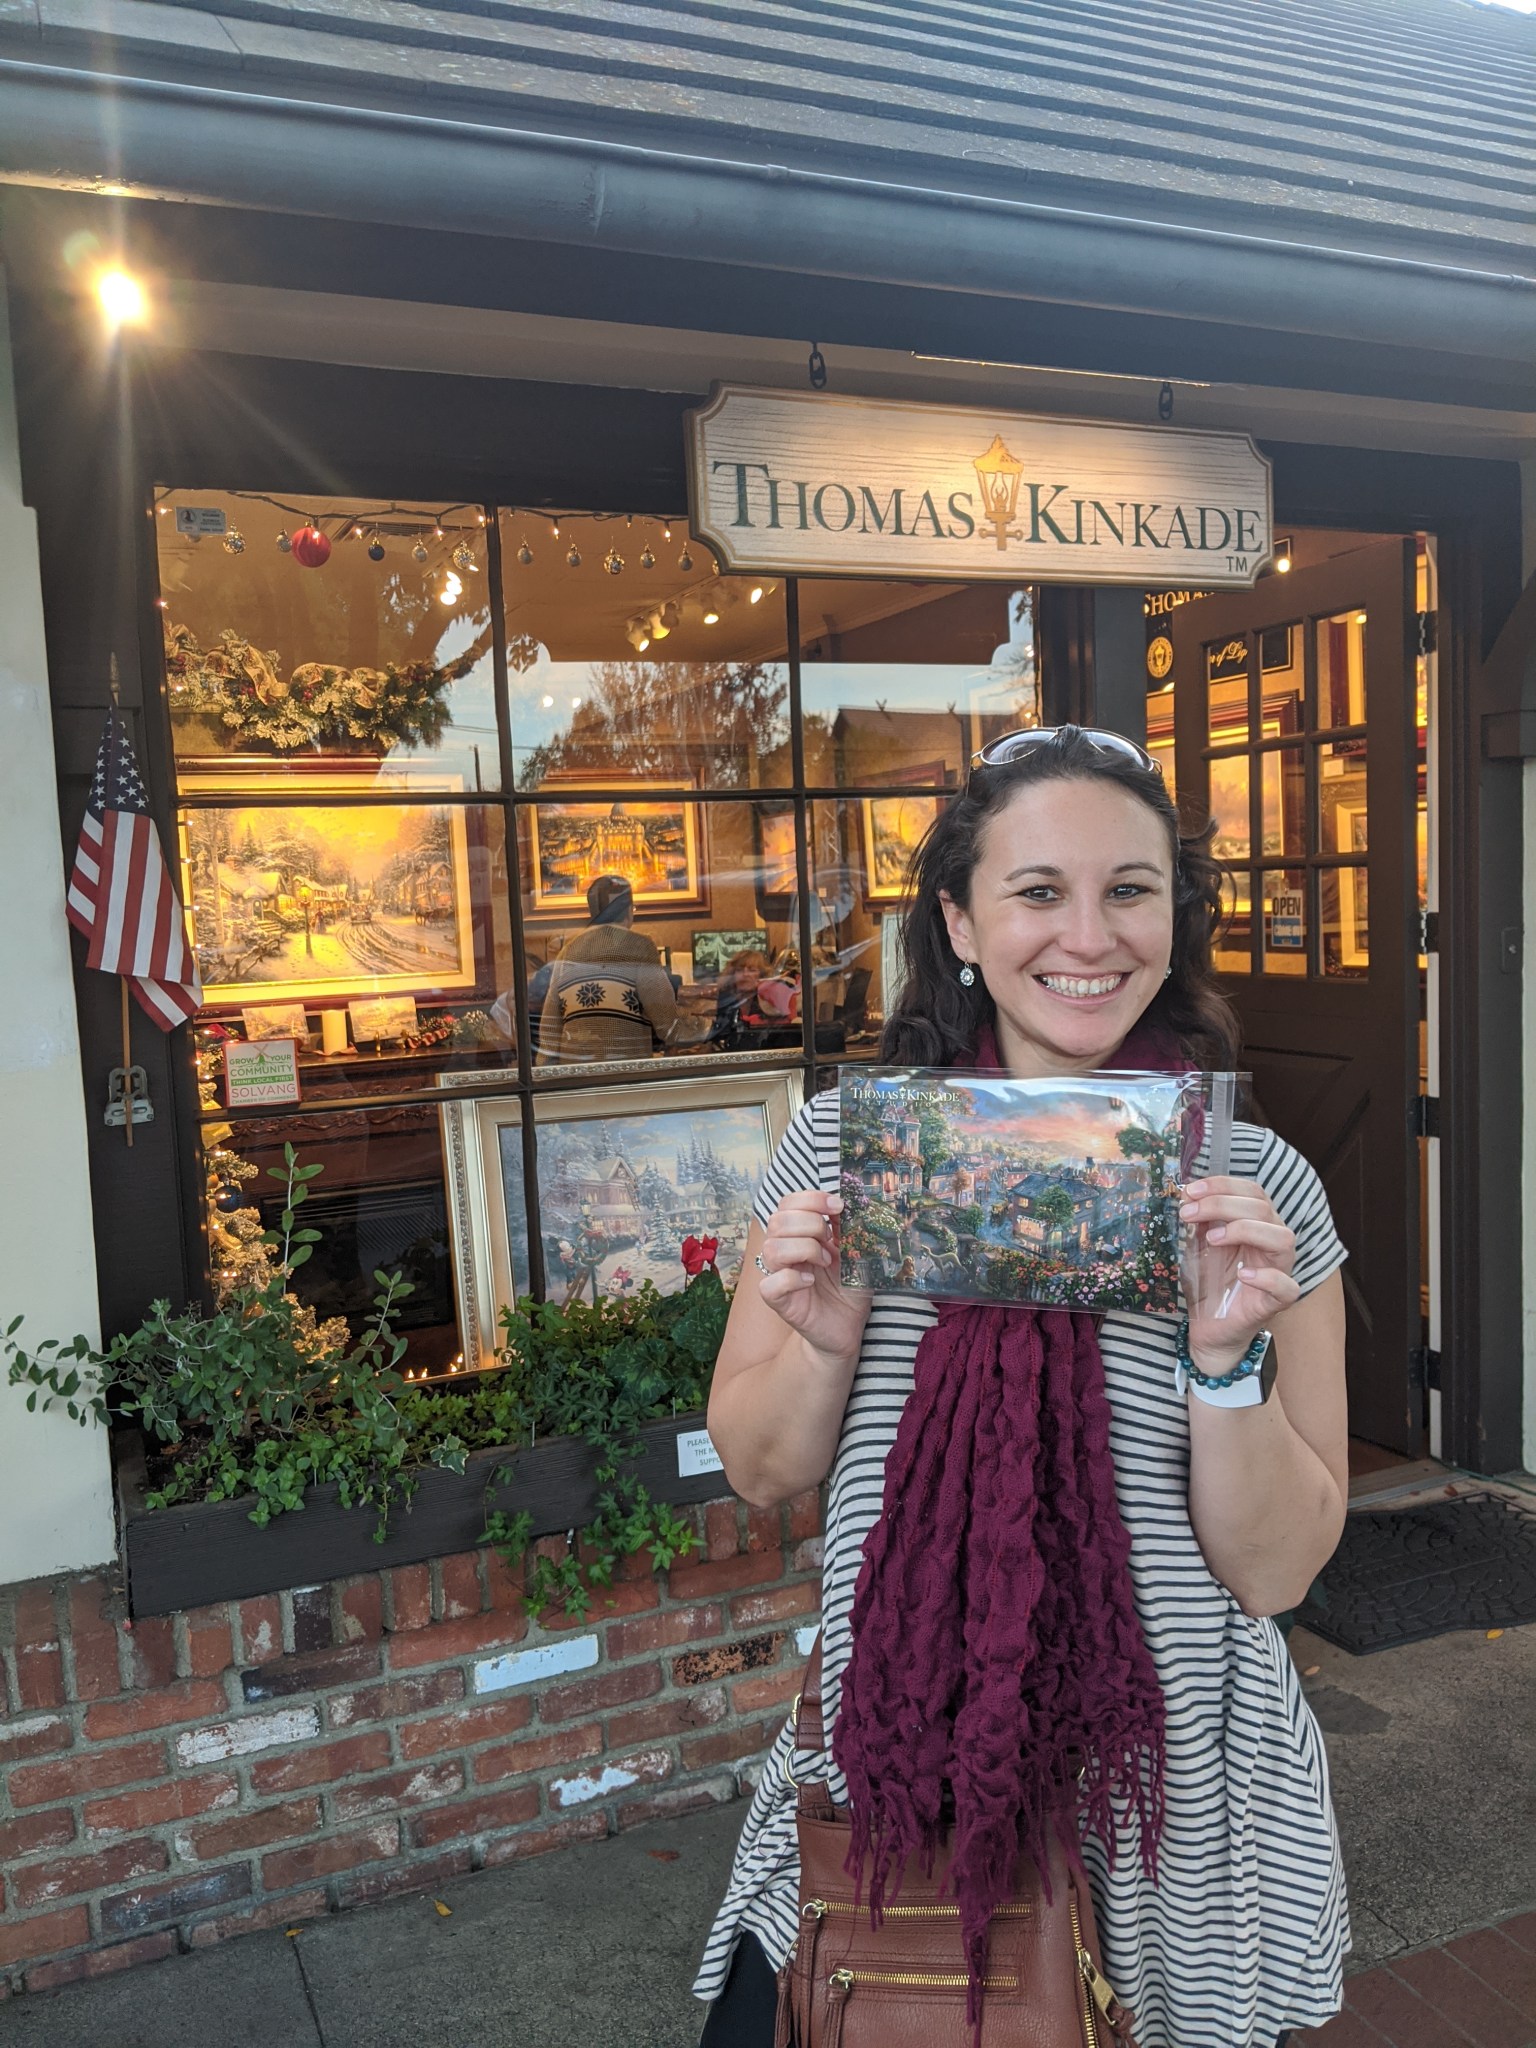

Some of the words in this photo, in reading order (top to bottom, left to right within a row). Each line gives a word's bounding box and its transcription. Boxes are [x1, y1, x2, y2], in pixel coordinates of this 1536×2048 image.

[713, 460, 975, 540] THOMAS
[1024, 483, 1264, 554] KINKADE
[1226, 556, 1248, 573] TM
[1273, 897, 1301, 916] OPEN
[229, 1057, 254, 1065] GROW
[270, 1054, 292, 1062] YOUR
[230, 1064, 293, 1077] COMMUNITY
[231, 1083, 296, 1098] SOLVANG
[850, 1087, 899, 1100] THOMAS
[906, 1089, 960, 1102] KINKADE
[694, 1448, 707, 1457] THE
